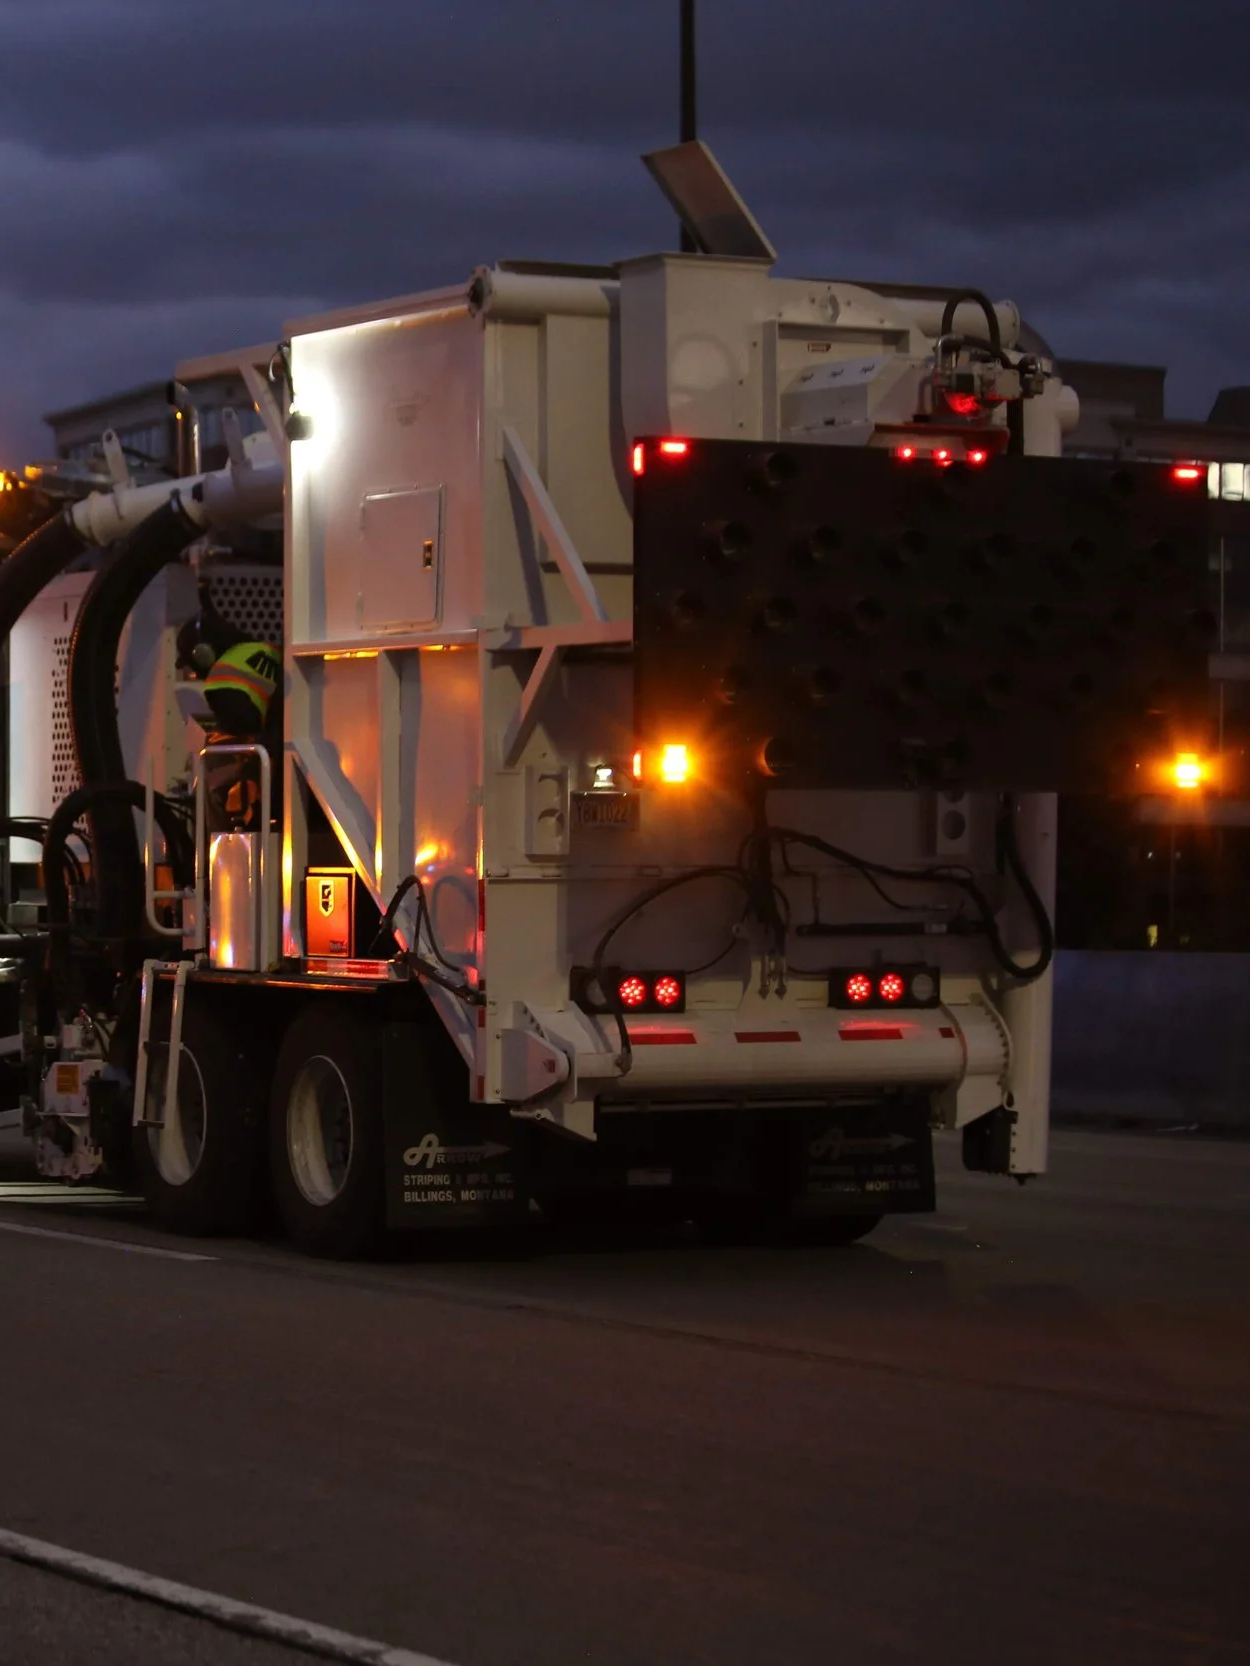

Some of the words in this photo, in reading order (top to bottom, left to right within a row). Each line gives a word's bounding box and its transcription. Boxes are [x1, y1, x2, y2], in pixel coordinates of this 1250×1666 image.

[403, 1173, 451, 1187] STRIPING
[864, 1179, 921, 1192] MONTANA
[403, 1190, 457, 1204] BILLINGS,
[460, 1189, 515, 1202] MONTANA
